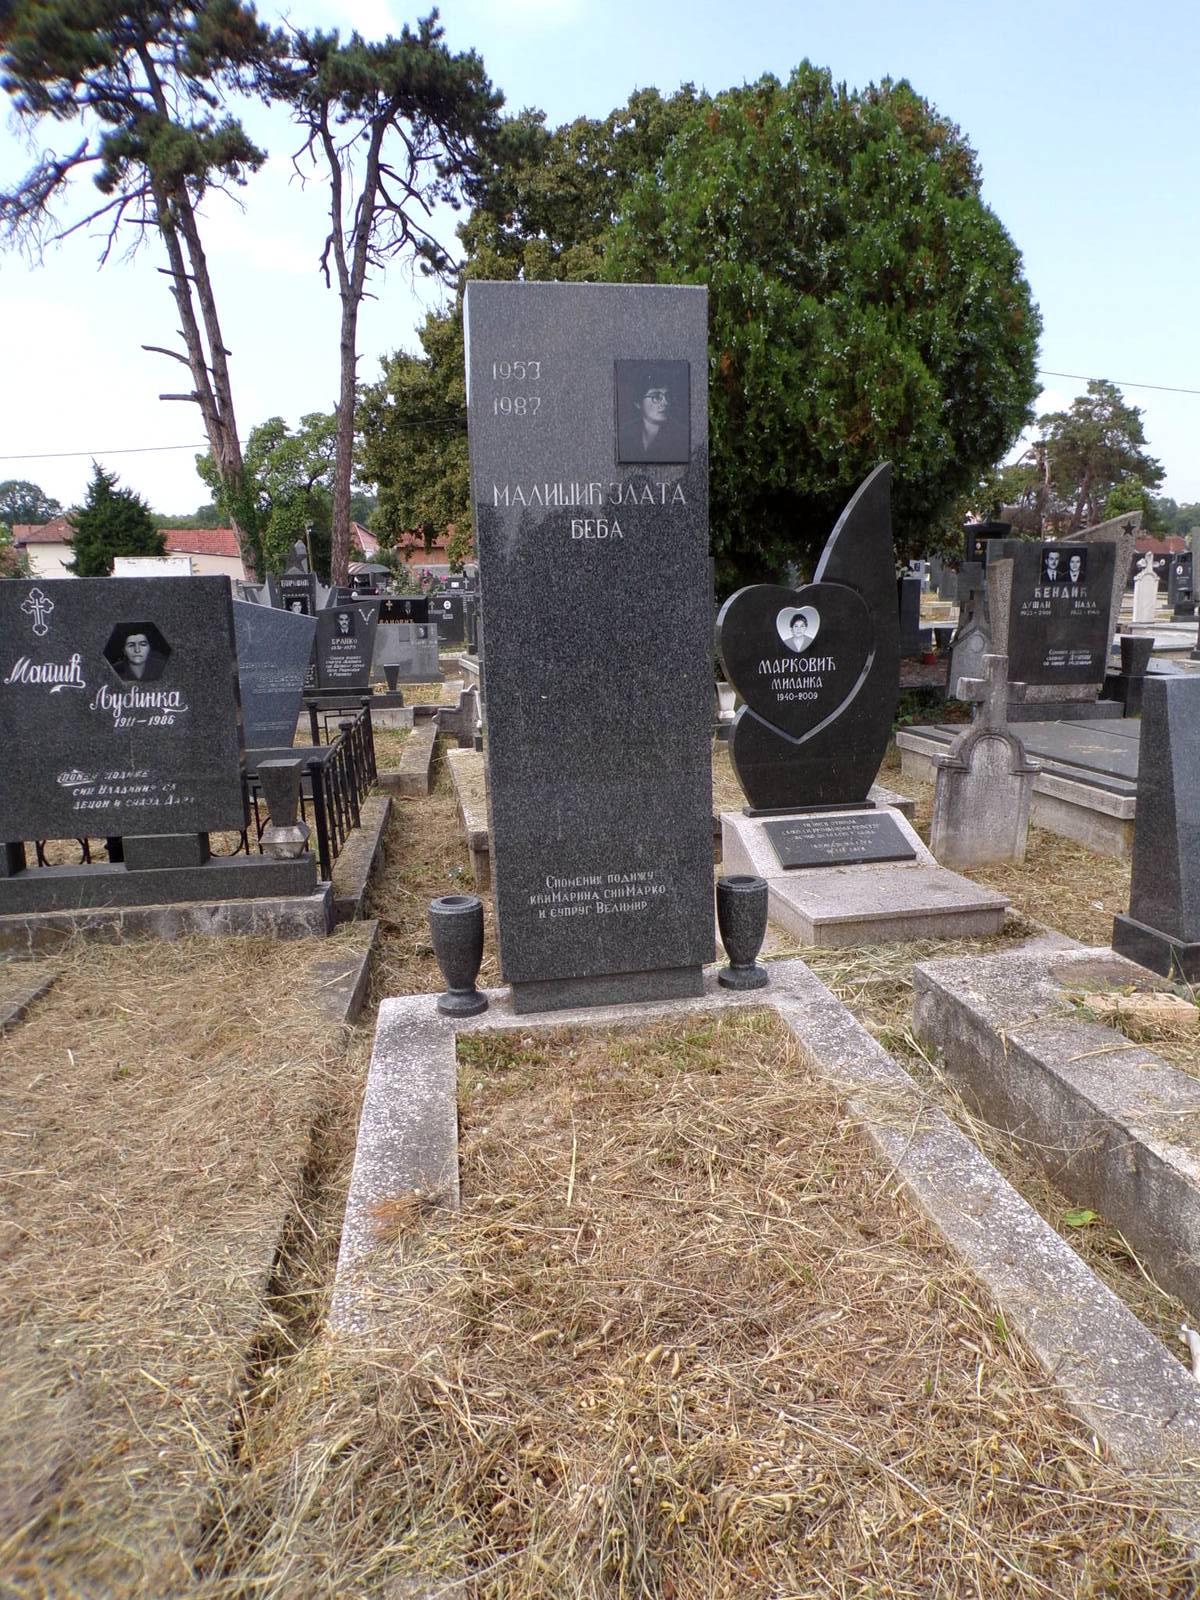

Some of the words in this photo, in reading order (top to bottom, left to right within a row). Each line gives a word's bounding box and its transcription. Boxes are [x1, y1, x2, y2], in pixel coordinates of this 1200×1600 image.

[492, 361, 541, 380] 1953
[494, 396, 541, 415] 1987
[608, 482, 687, 505] ЗЛАТА
[571, 519, 624, 539] БЕБА
[758, 656, 837, 675] МАРКОВИЋ
[771, 676, 824, 690] МИЛАНКА
[776, 691, 819, 702] 1940-2009
